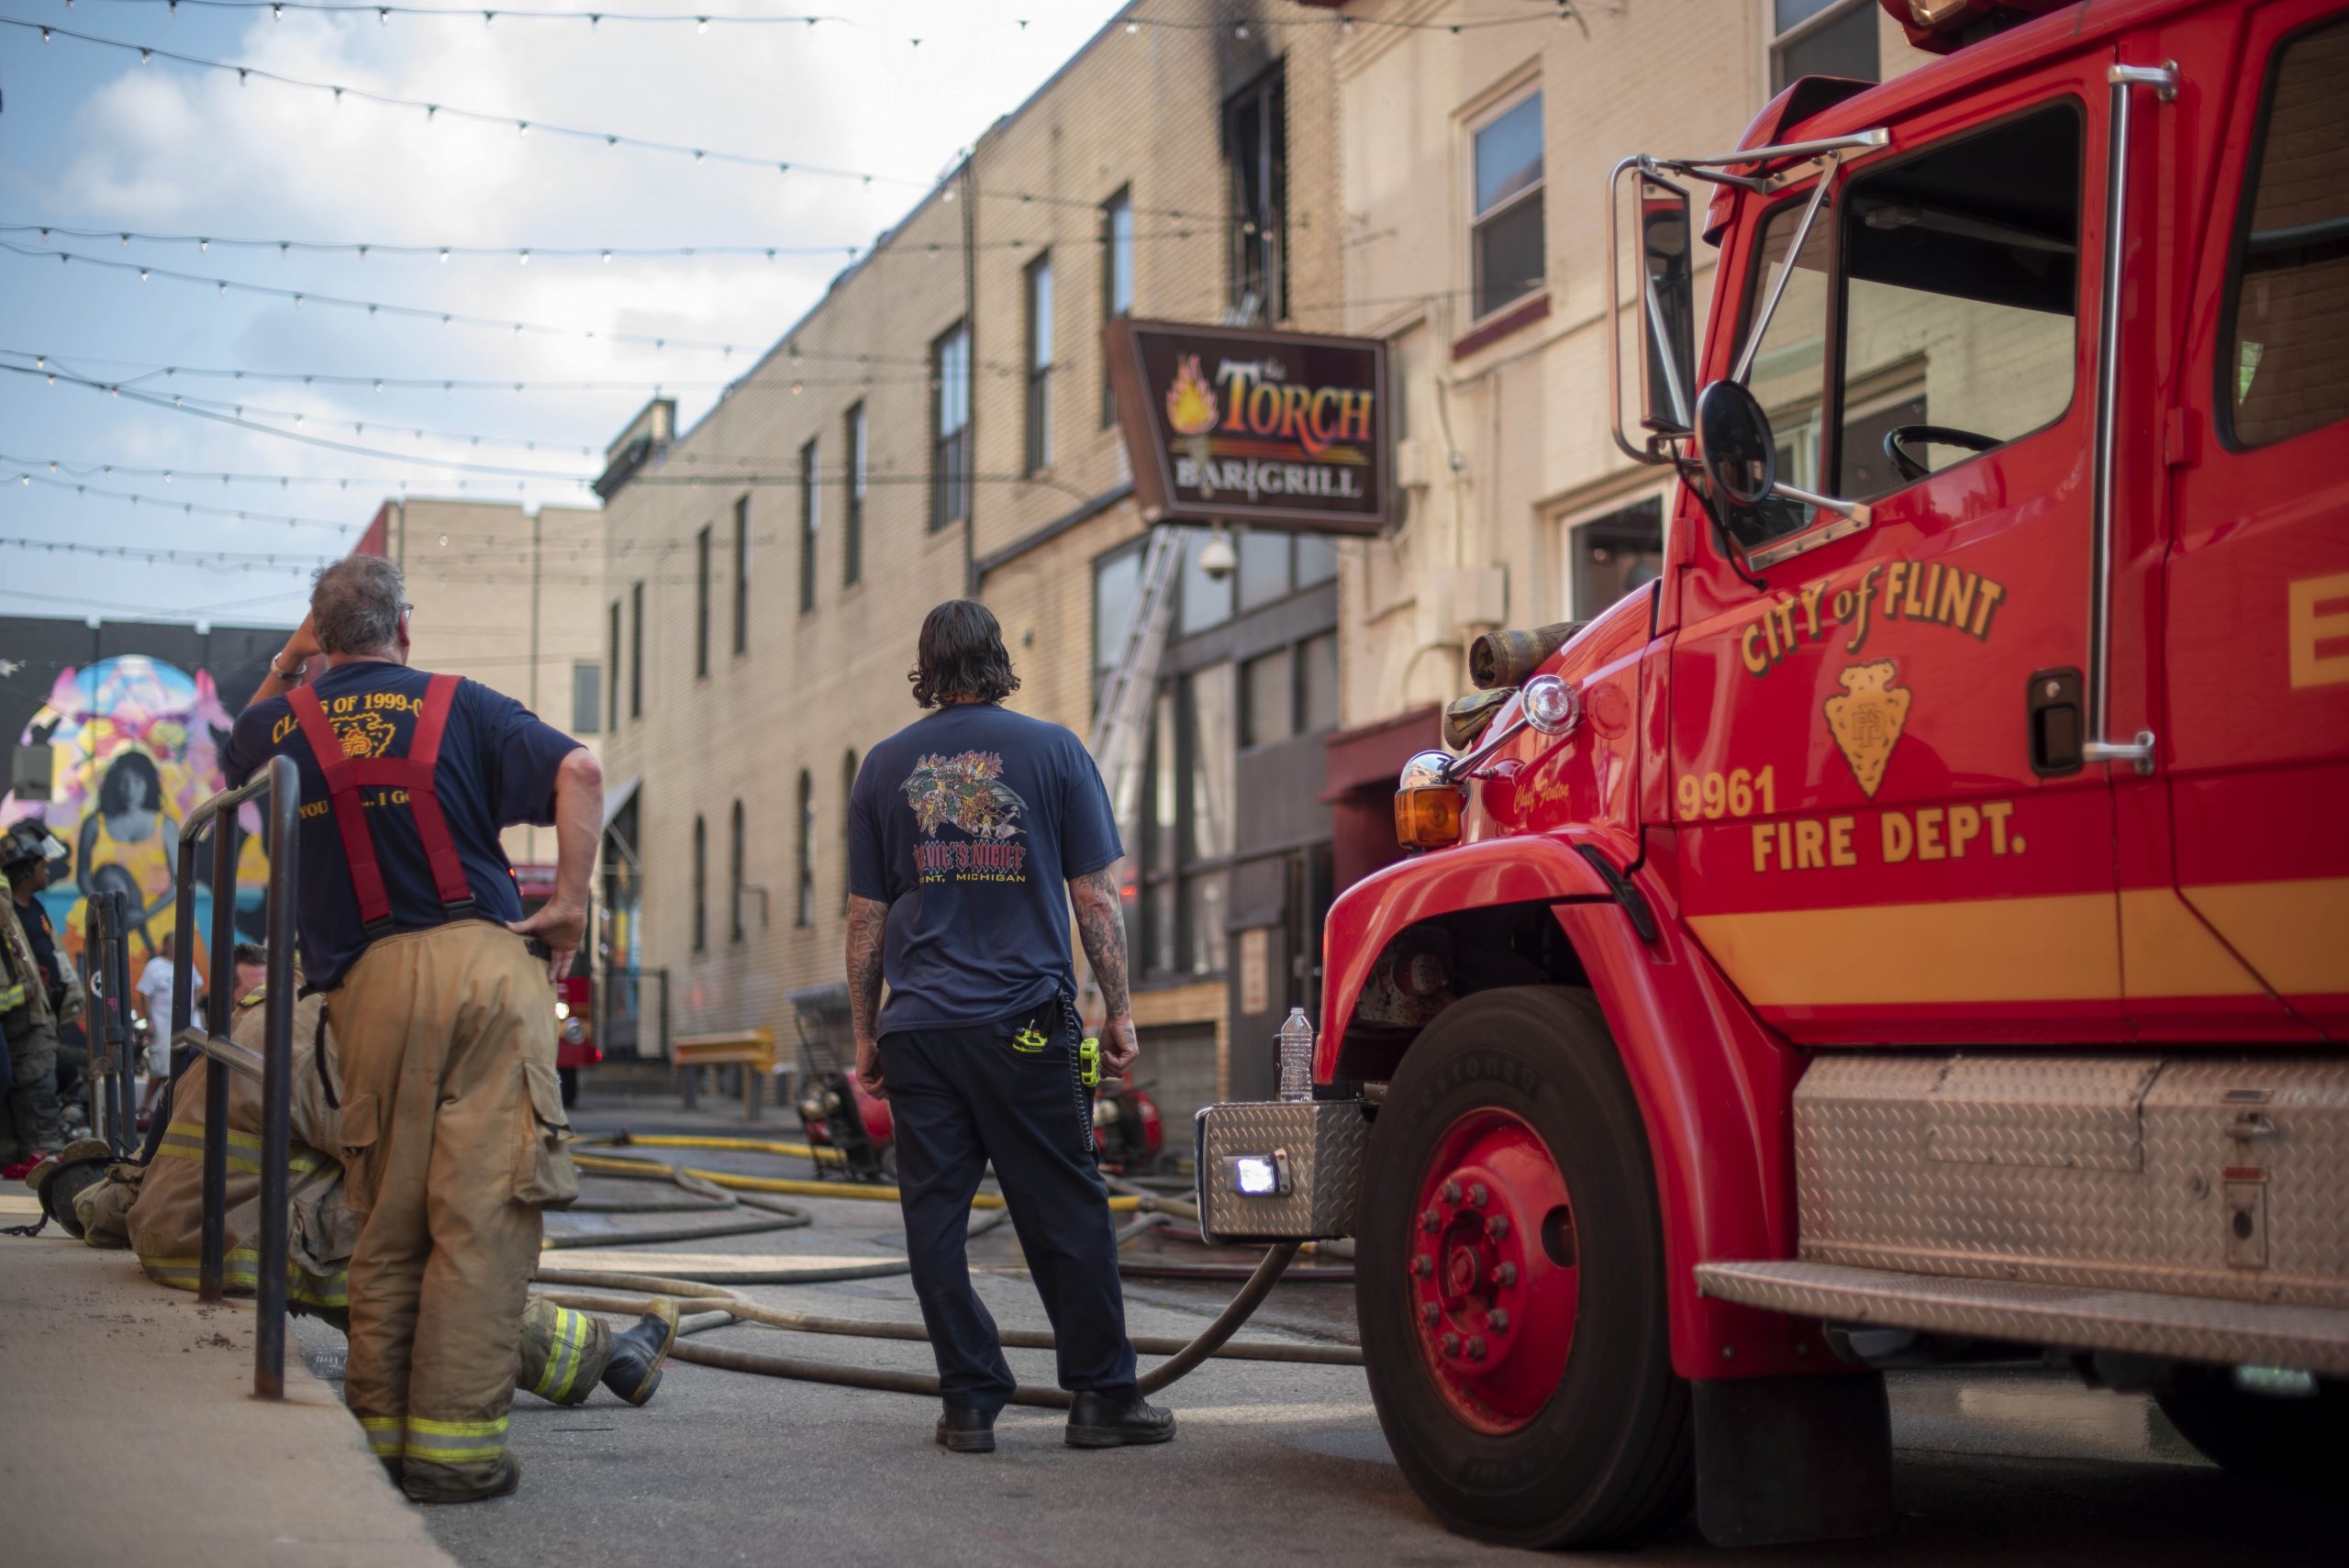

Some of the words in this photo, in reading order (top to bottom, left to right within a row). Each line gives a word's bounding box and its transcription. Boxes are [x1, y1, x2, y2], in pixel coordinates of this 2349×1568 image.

[1216, 360, 1374, 455] TORCH
[1175, 459, 1247, 490] BAR
[1257, 465, 1364, 498] GRILL
[1743, 580, 1829, 677] CITY
[1835, 565, 1882, 653] of
[1884, 561, 2005, 640] FLINT
[273, 700, 329, 744] CLS
[333, 695, 358, 714] OF
[362, 693, 424, 718] 1999-0
[299, 799, 329, 818] YOU
[1677, 765, 1776, 821] 9961
[970, 839, 1026, 874] NIGHT
[1751, 816, 1857, 873] FIRE
[1881, 801, 2026, 864] DEPT.
[955, 873, 1026, 882] MICHIGAN
